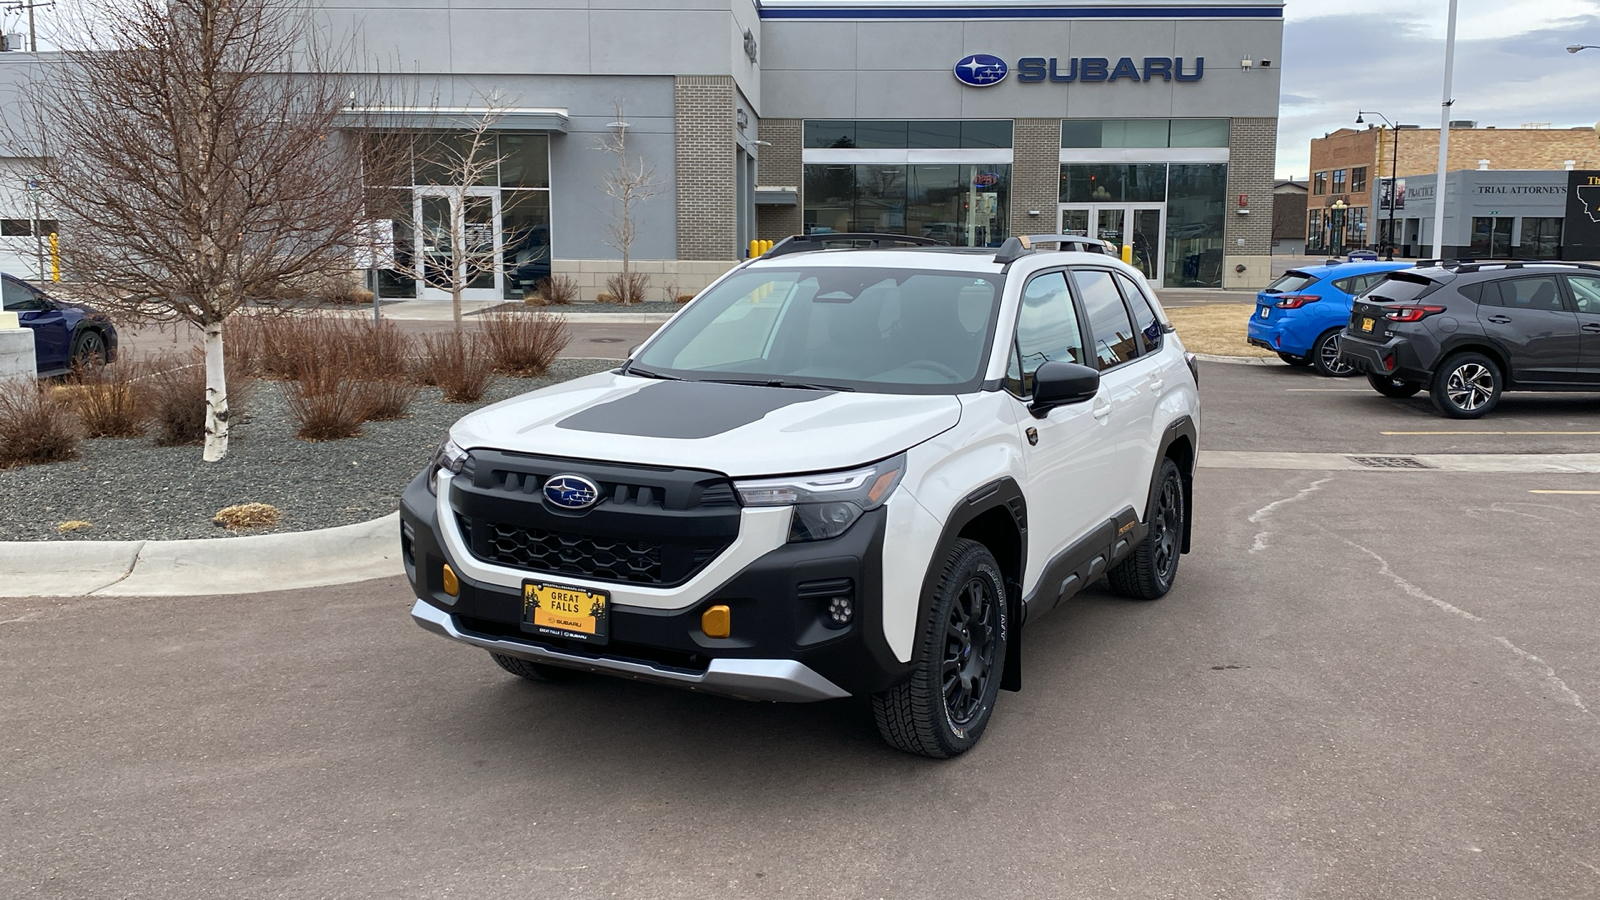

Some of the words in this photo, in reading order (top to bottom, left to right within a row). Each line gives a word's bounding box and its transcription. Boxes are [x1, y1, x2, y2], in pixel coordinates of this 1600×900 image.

[1017, 57, 1204, 83] SUBARU
[1408, 187, 1434, 198] PRACTICE
[1478, 186, 1508, 194] TRIAL
[1510, 186, 1567, 194] ATTORNEYS
[551, 591, 579, 603] GREAT
[551, 601, 579, 613] FALLS
[556, 619, 582, 627] SUBARU
